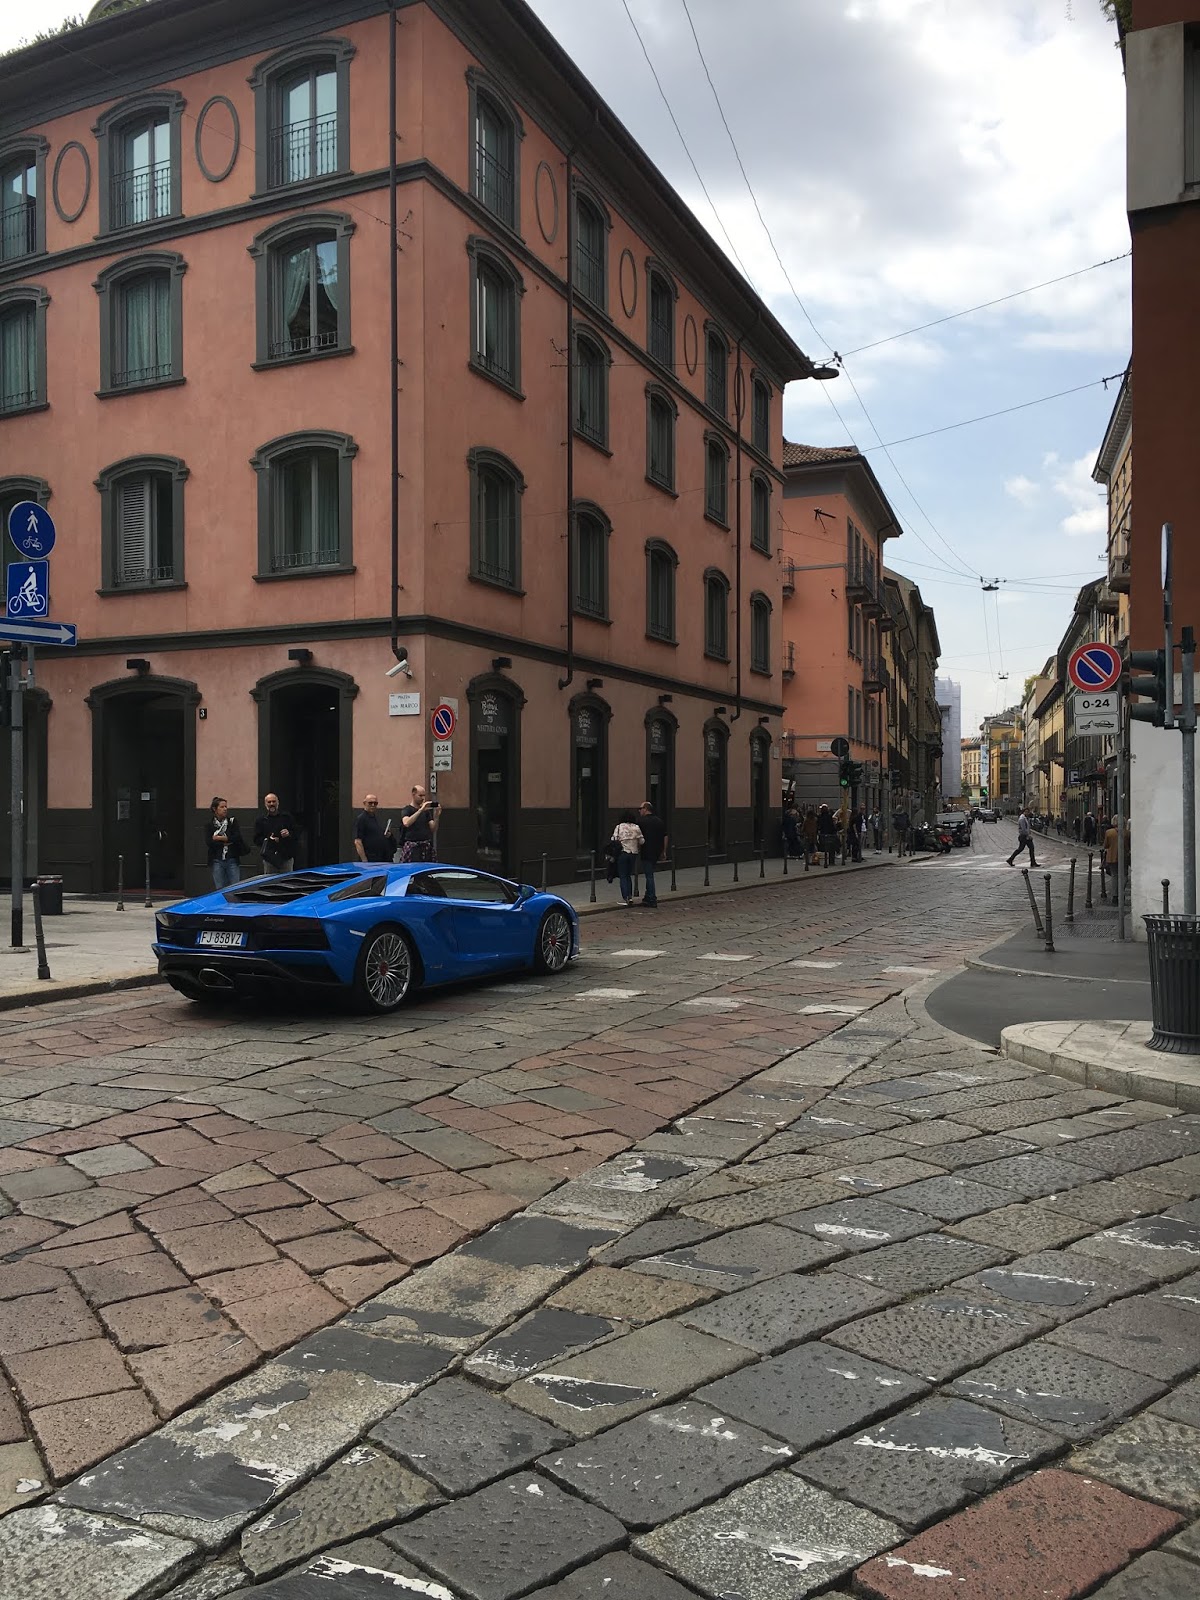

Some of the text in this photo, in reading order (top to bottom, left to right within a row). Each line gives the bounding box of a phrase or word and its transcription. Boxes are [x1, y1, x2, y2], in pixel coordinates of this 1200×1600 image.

[1082, 698, 1110, 709] 0-24
[200, 709, 205, 718] 3
[436, 744, 449, 752] 0-24
